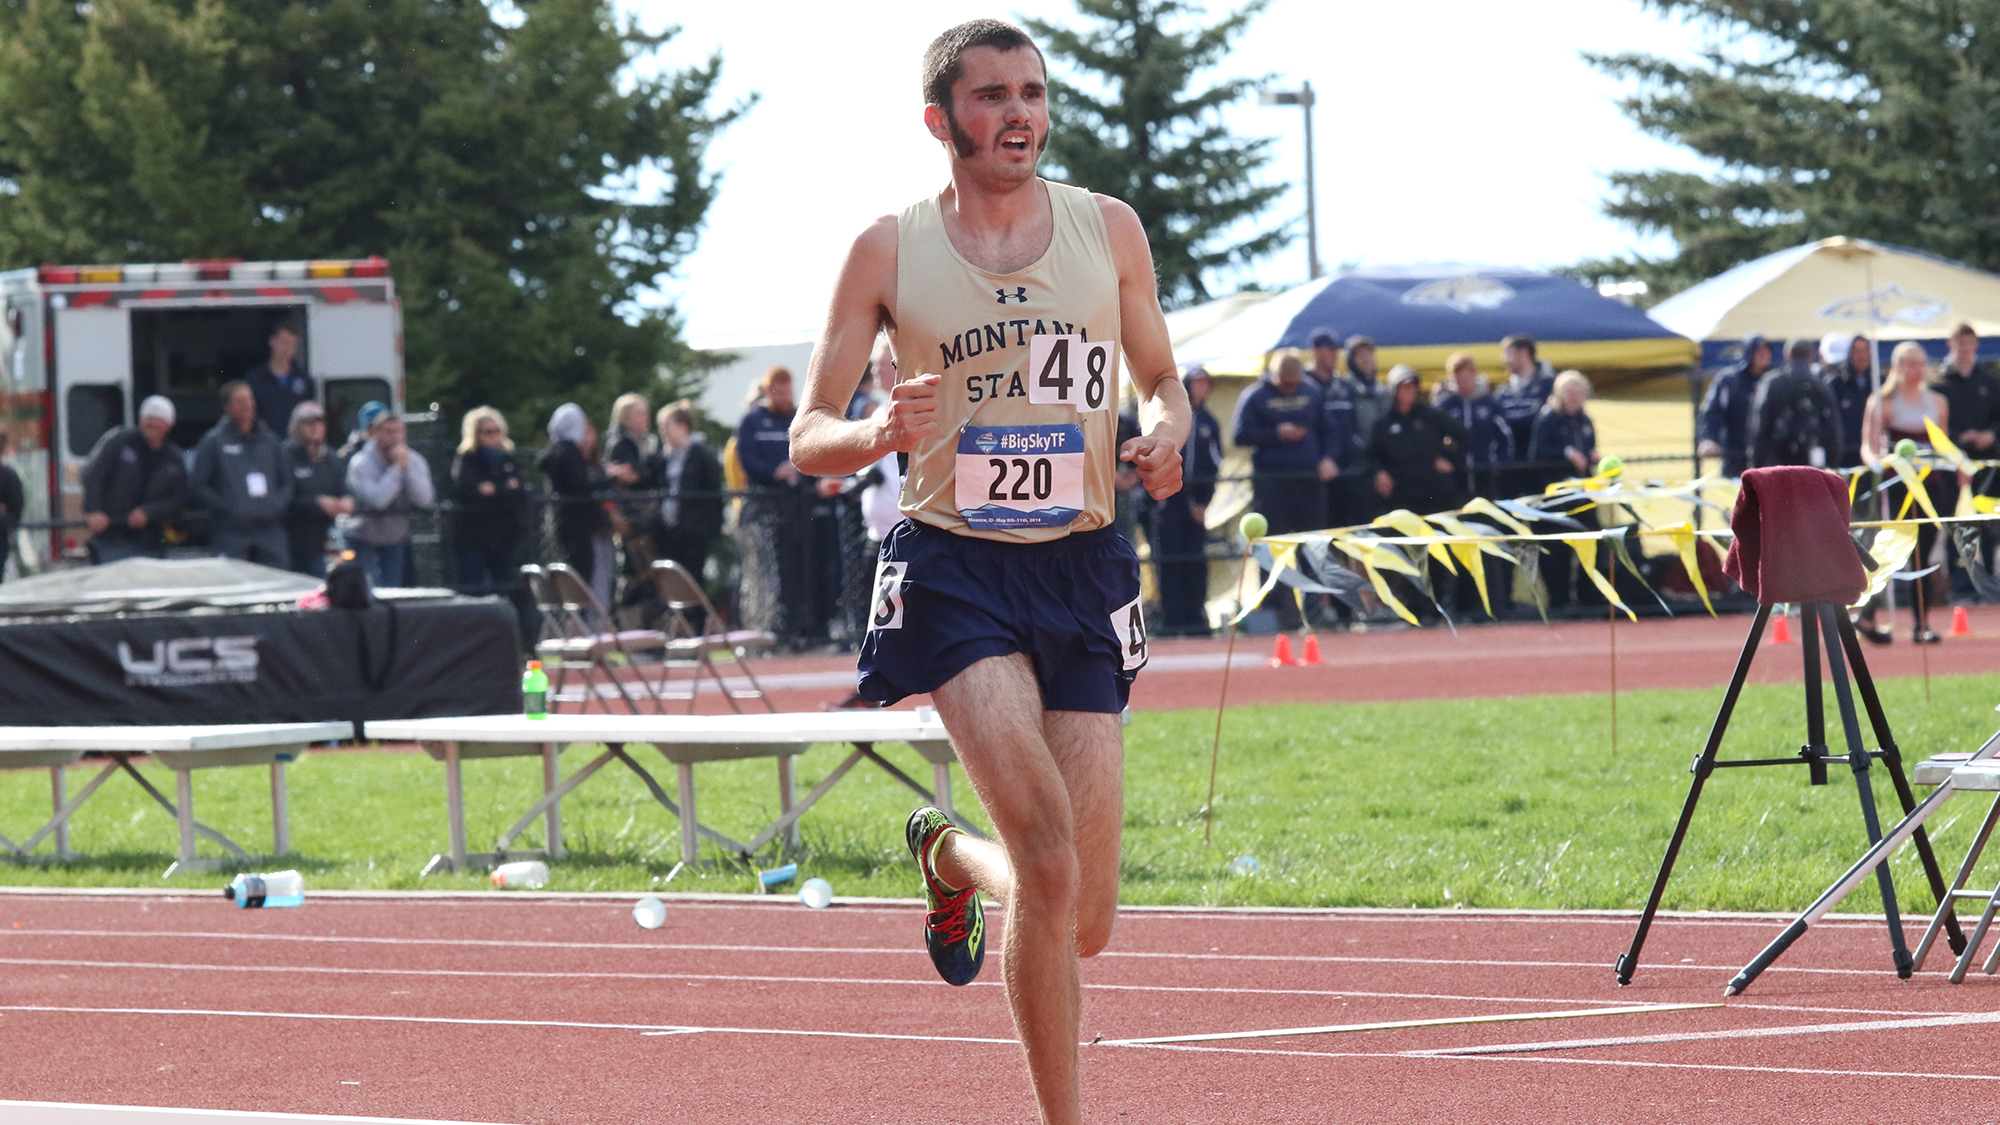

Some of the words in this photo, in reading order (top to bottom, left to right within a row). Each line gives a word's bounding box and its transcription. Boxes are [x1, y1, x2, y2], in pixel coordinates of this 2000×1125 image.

[966, 370, 1026, 403] STA
[1001, 432, 1066, 452] #BigSkyTF
[988, 457, 1052, 501] 220
[873, 565, 898, 627] 8
[1128, 603, 1147, 660] 4
[117, 635, 261, 675] UCS
